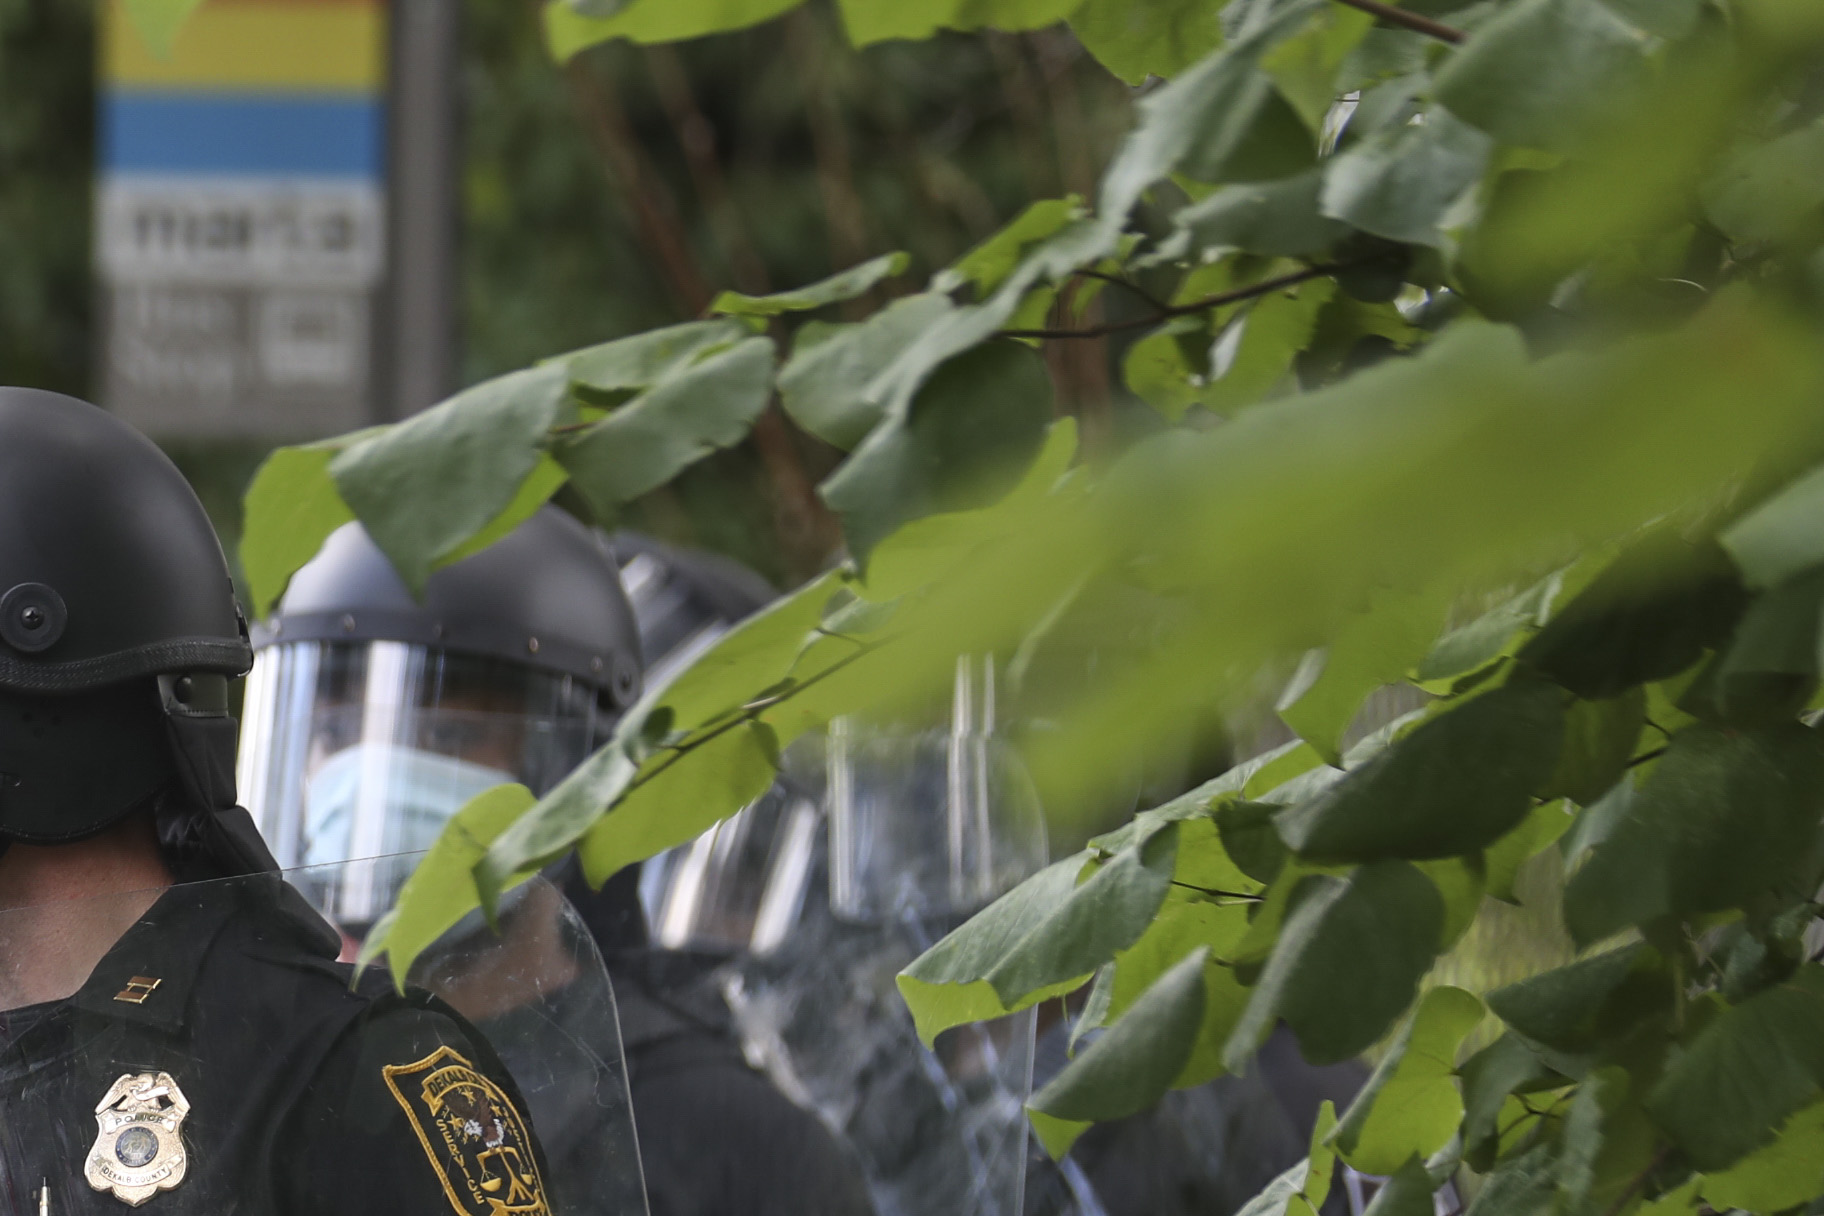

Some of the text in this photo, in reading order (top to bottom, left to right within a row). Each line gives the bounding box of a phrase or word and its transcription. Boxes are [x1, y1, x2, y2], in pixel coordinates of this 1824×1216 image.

[102, 1165, 167, 1183] DEKALB COUNTY
[436, 1119, 485, 1204] SERVICE
